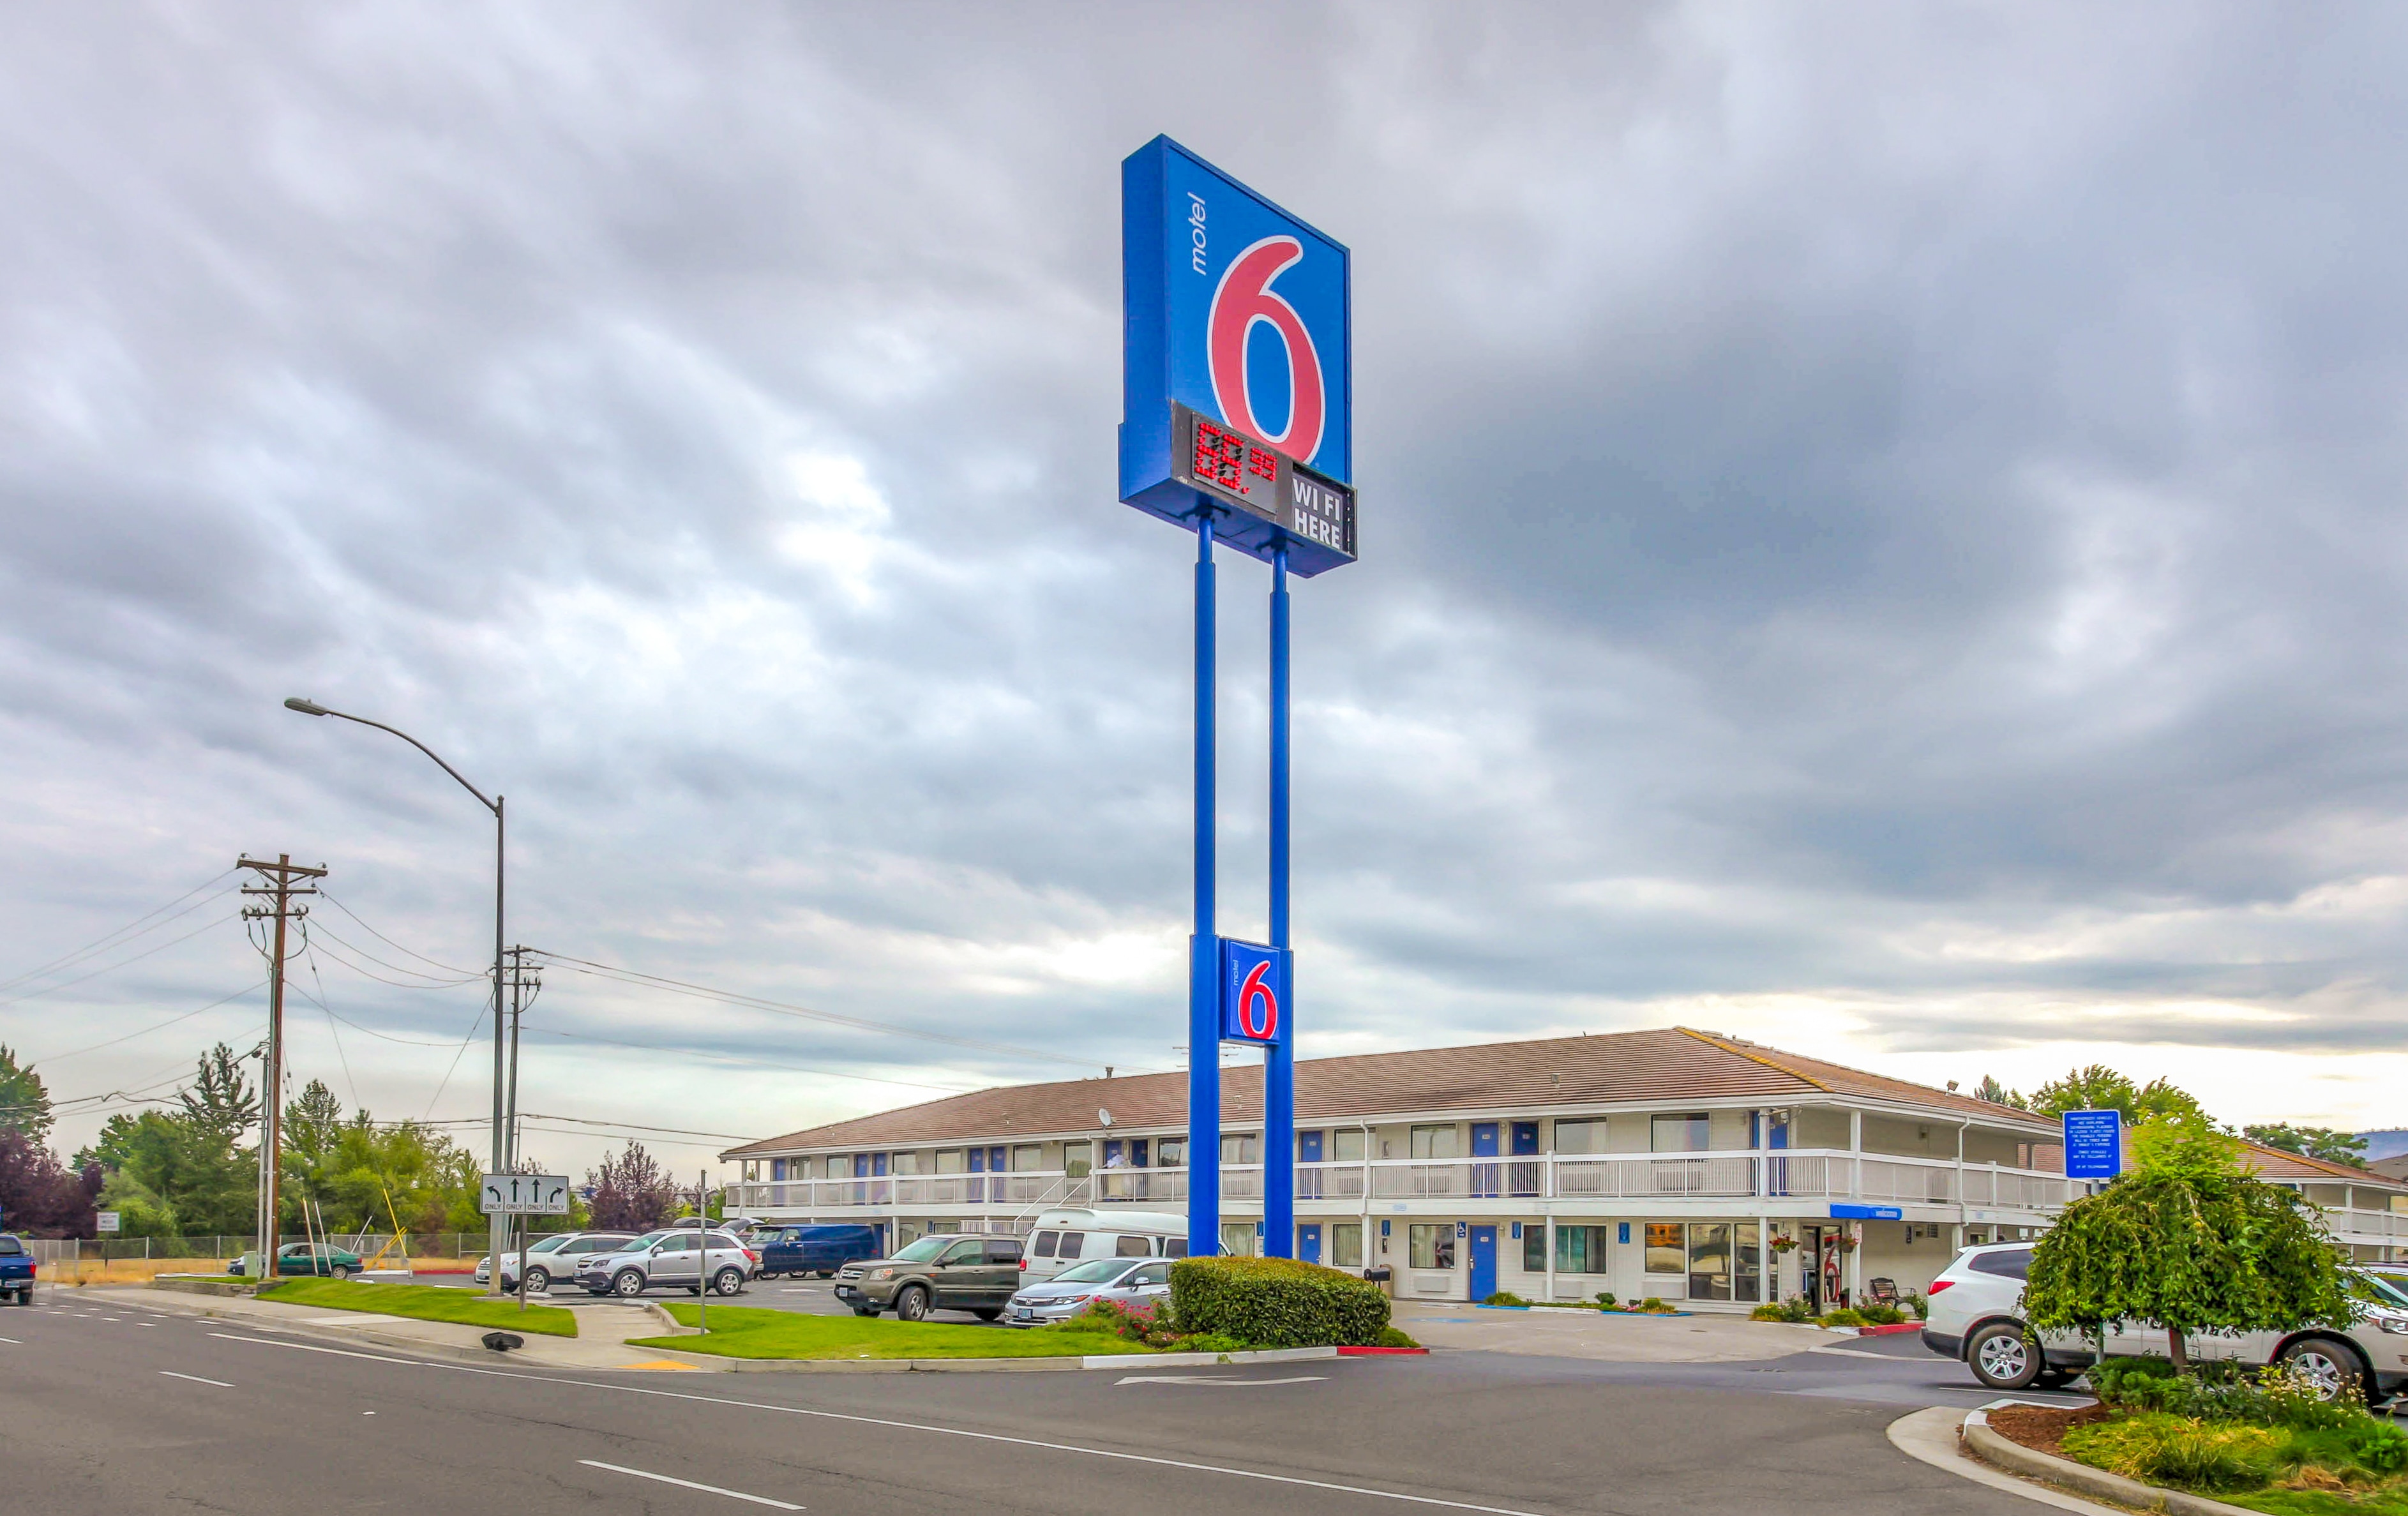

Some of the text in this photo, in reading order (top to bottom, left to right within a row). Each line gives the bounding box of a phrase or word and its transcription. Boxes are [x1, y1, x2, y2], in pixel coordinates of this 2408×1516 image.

[1187, 191, 1207, 276] motel
[1207, 235, 1325, 466] 6
[1292, 477, 1340, 522] WI FI
[1295, 507, 1340, 550] HERE
[1238, 961, 1277, 1039] 6
